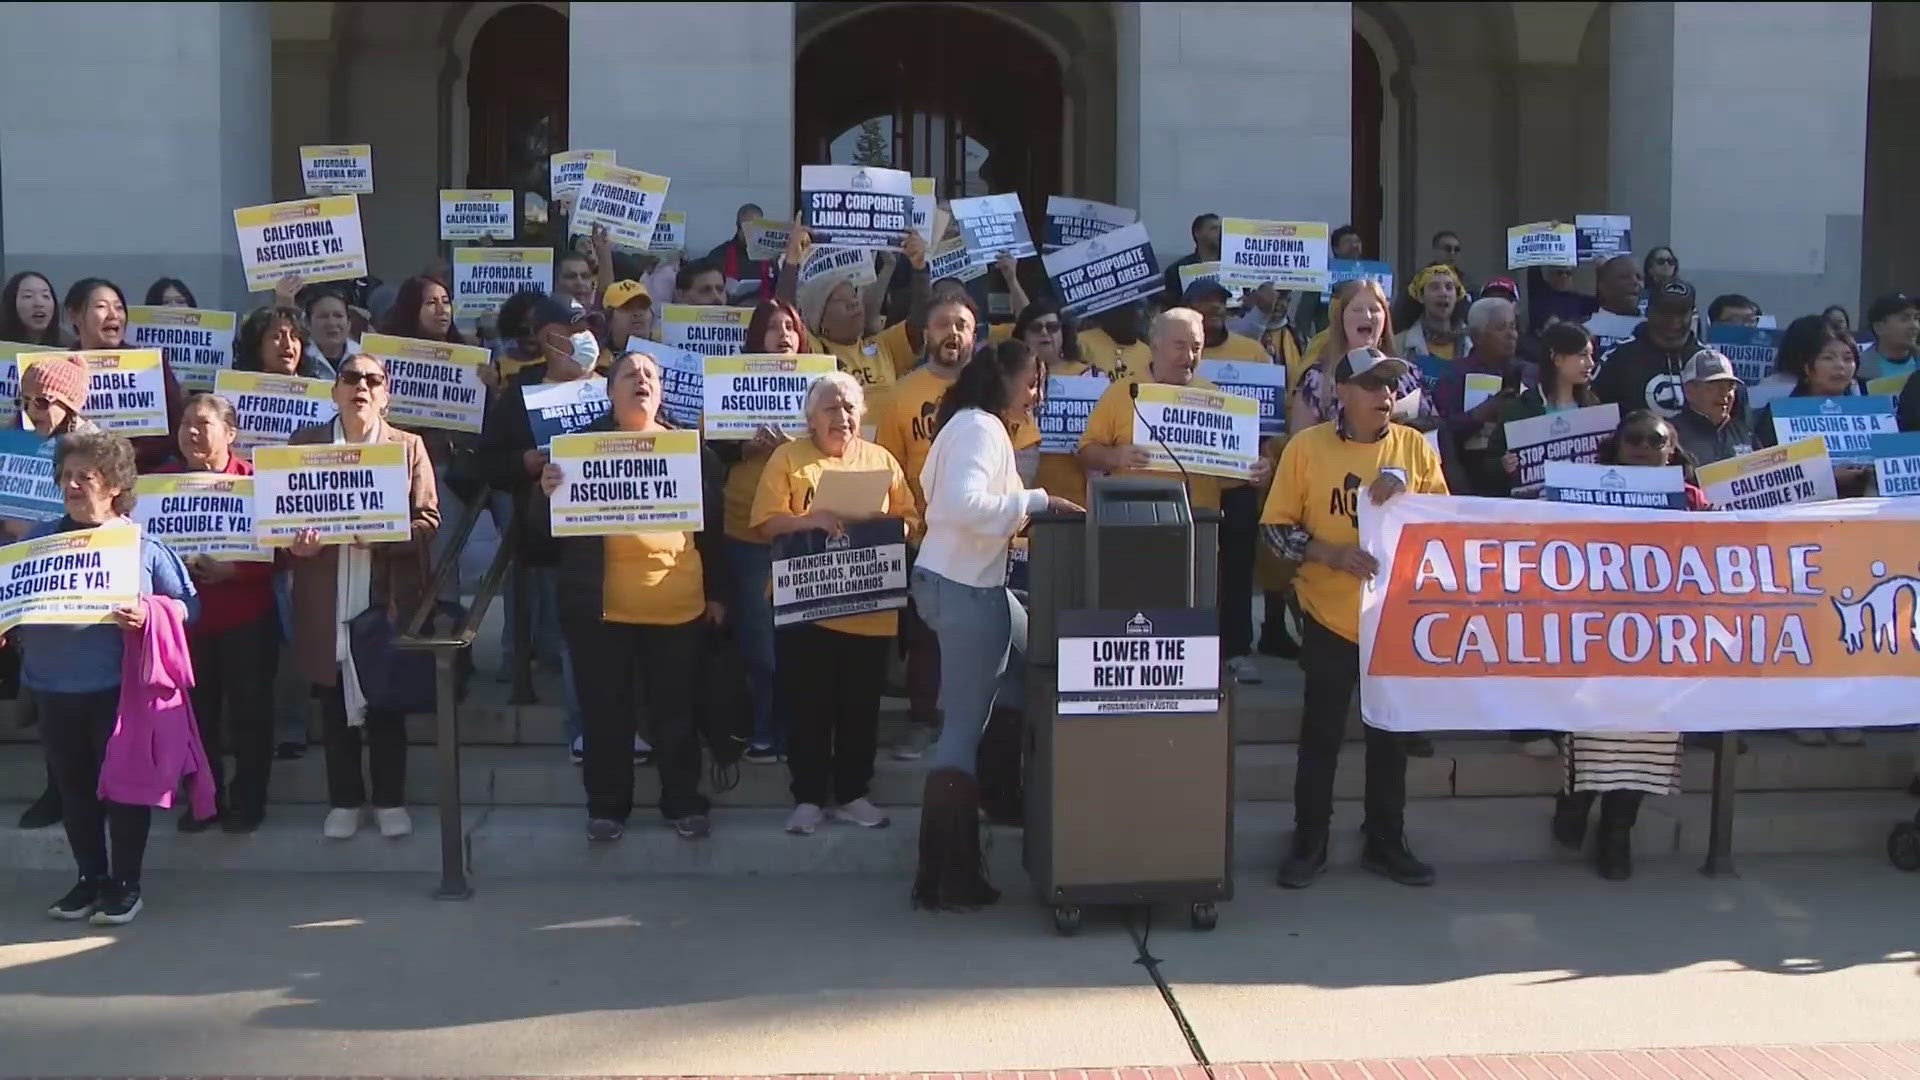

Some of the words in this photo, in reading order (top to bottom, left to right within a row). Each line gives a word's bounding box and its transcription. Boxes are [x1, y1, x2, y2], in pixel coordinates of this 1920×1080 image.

[313, 158, 357, 168] AFFORDABLE
[307, 169, 345, 179] CALIFORNIA
[591, 182, 646, 207] AFFORDABLE
[812, 193, 843, 209] STOP
[845, 195, 905, 213] CORPORATE
[446, 213, 488, 224] CALIFORNIA
[489, 213, 509, 224] NOW!
[454, 203, 500, 213] AFFORDABLE
[580, 196, 627, 218] CALIFORNIA
[627, 206, 653, 225] NOW!
[263, 219, 333, 243] CALIFORNIA
[812, 211, 871, 228] LANDLORD
[873, 213, 905, 230] GREED
[1244, 237, 1304, 253] CALIFORNIA
[1522, 233, 1561, 244] CALIFORNIA
[256, 241, 320, 263] ASEQUIBLE
[322, 237, 343, 254] YA!
[835, 249, 864, 267] NOW!
[1235, 251, 1290, 267] ASEQUIBLE
[1293, 255, 1310, 269] YA!
[471, 265, 533, 279] AFFORDABLE
[1060, 268, 1084, 289] STOP
[1087, 247, 1145, 278] CORPORATE
[460, 281, 515, 295] CALIFORNIA
[1064, 276, 1116, 304] LANDLORD
[1117, 262, 1150, 284] GREED
[136, 327, 213, 347] AFFORDABLE
[195, 348, 224, 366] NOW!
[1720, 344, 1773, 362] HOUSING
[385, 359, 463, 384] AFFORDABLE
[389, 379, 438, 400] IFORNIA
[442, 384, 476, 405] NOW!
[733, 376, 808, 393] CALIFORNIA
[119, 391, 155, 409] NOW!
[237, 394, 319, 418] AFFORDABLE
[574, 403, 588, 415] DE
[588, 401, 601, 413] LA
[721, 394, 792, 411] ASEQUIBLE
[236, 413, 293, 434] LIFORNIA
[561, 416, 574, 429] DE
[574, 414, 592, 427] LOS
[1162, 406, 1234, 431] CALIFORNIA
[1790, 417, 1848, 432] HOUSING
[1852, 416, 1866, 431] IS
[1870, 415, 1880, 430] A
[1150, 426, 1217, 448] ASEQUIBLE
[1221, 431, 1240, 450] YA!
[1519, 445, 1545, 466] STOP
[8, 456, 53, 477] VIVIEND
[583, 458, 668, 479] CALIFORNIA
[1884, 459, 1900, 475] LA
[288, 469, 375, 492] CALIFORNIA
[1731, 464, 1804, 496] CALIFORNIA
[1794, 481, 1816, 499] YA!
[570, 481, 649, 502] ASEQUIBLE
[654, 480, 677, 499] YA!
[1560, 488, 1593, 502] ¡BASTA
[1595, 490, 1608, 503] DE
[1609, 491, 1622, 504] LA
[1624, 493, 1669, 506] AVARICIA
[161, 496, 243, 514] CALIFORNIA
[275, 493, 355, 515] ASEQUIBLE
[361, 491, 384, 510] YA!
[147, 514, 226, 535] ASEQUIBLE
[229, 517, 251, 532] YA!
[11, 551, 101, 580] CALIFORNIA
[788, 554, 833, 572] FINANCIEN
[836, 549, 877, 566] VIVIENDA
[1414, 538, 1826, 595] AFFORDABLE
[85, 571, 110, 590] YA!
[778, 575, 790, 588] NO
[792, 568, 847, 585] DESALOJOS,
[849, 560, 889, 578] POLICÍAS
[892, 559, 901, 572] NI
[795, 577, 884, 600] MULTIMILLONARIOS
[1412, 611, 1813, 666] CALIFORNIA
[1093, 641, 1149, 662] LOWER
[1156, 639, 1185, 660] THE
[1093, 666, 1134, 687] RENT
[1140, 665, 1184, 686] NOW!
